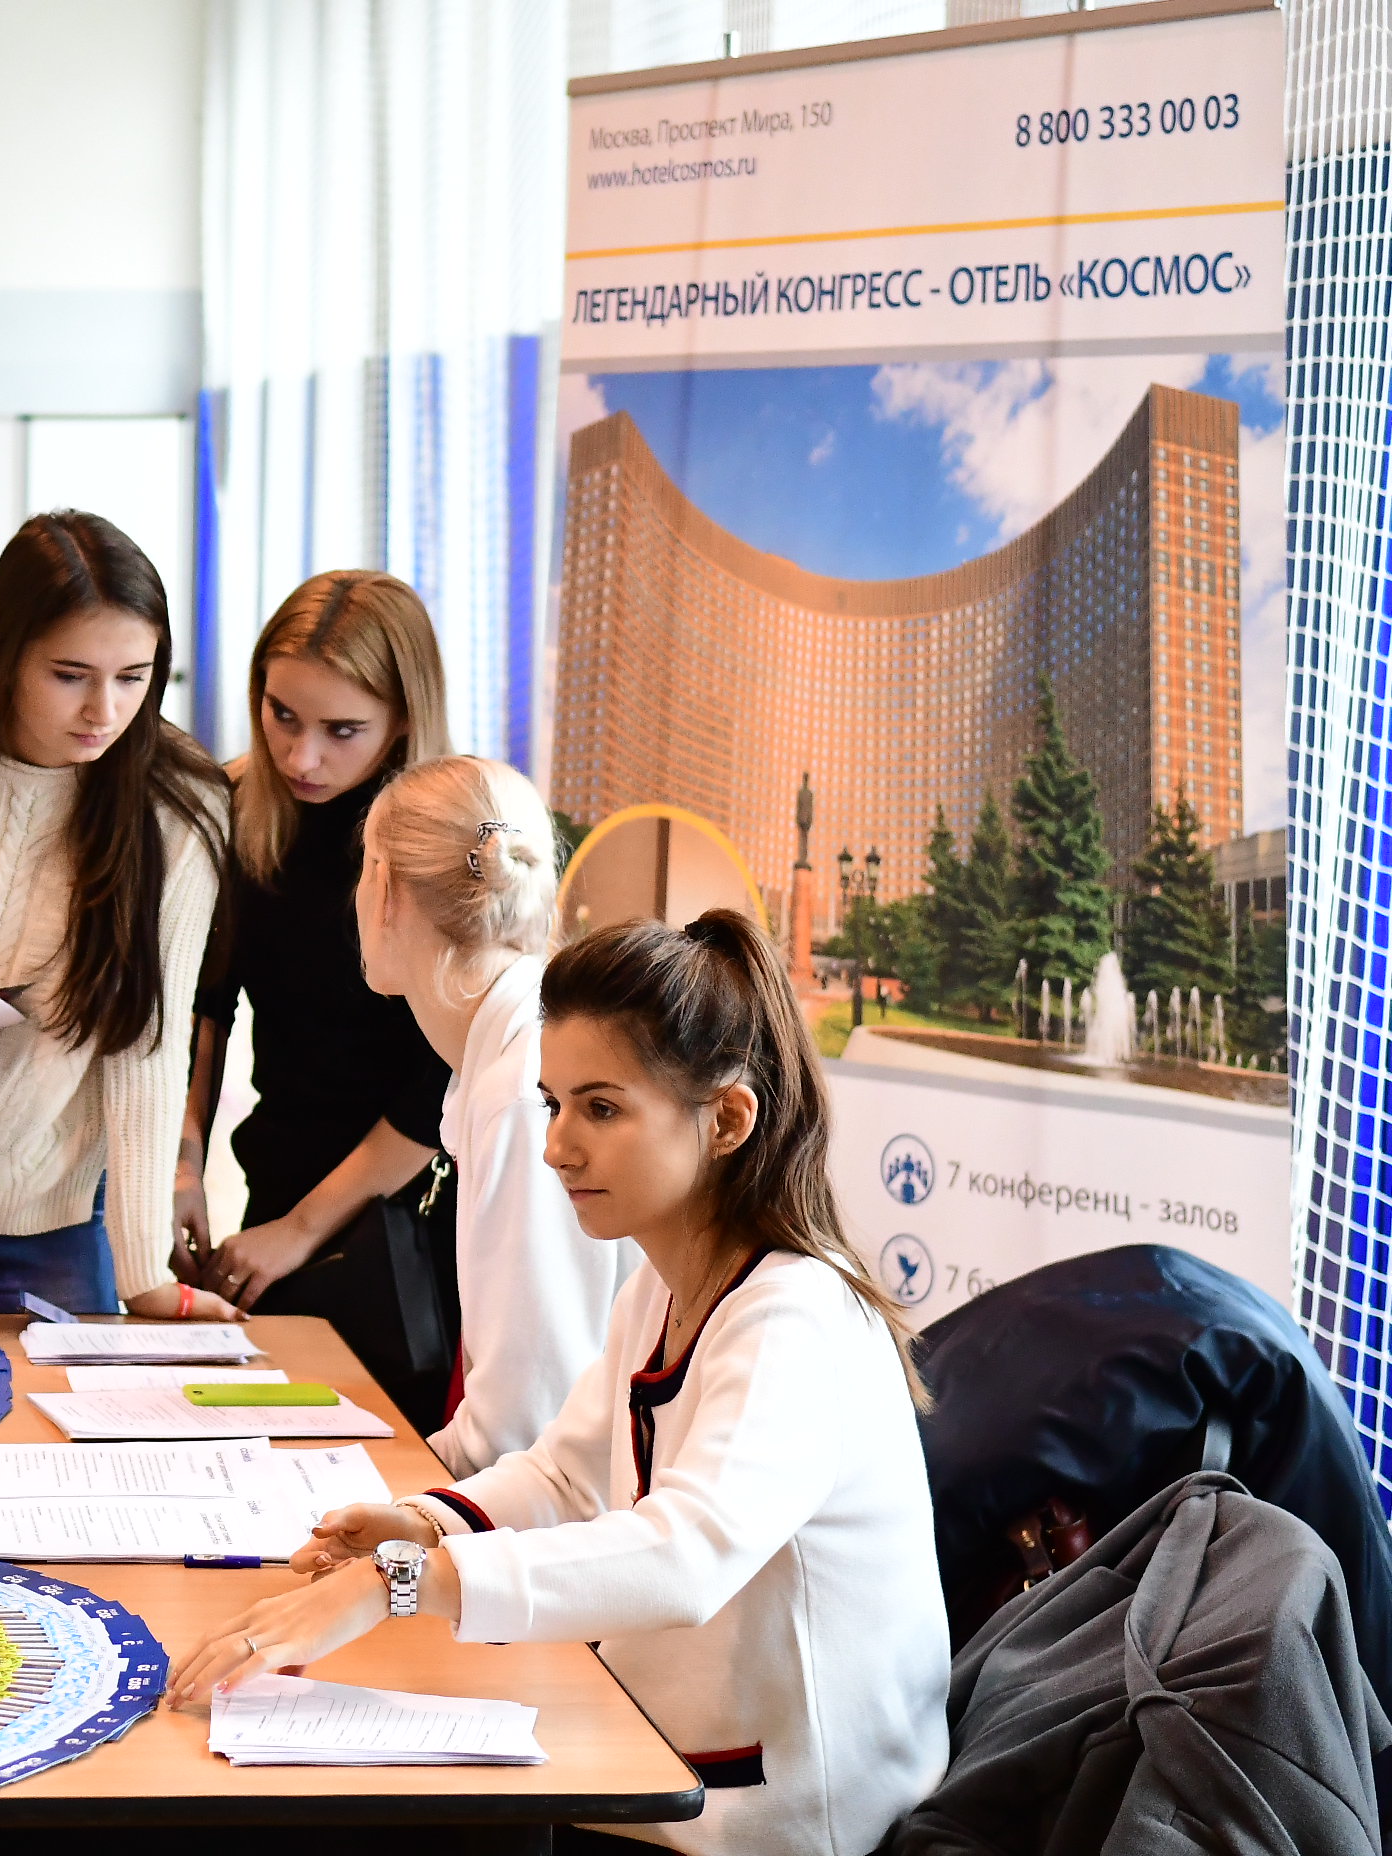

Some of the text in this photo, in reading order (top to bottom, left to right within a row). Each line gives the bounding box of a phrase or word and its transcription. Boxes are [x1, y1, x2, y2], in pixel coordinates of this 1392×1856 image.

[587, 101, 833, 150] Москва, Проспект Мира, 150
[1016, 93, 1240, 147] 8 800 333 00 03
[587, 157, 757, 189] www.hotelcosmos.ru
[573, 271, 770, 327] ЛЕГЕНДАРНЫЙ
[777, 269, 923, 314] КОНГРЕСС
[949, 263, 1051, 305] ОТЕЛЬ
[1058, 251, 1252, 299] «КОСМОС»
[946, 1160, 961, 1188] 7
[968, 1170, 1132, 1221] конференц
[1158, 1198, 1240, 1235] залов
[945, 1264, 960, 1293] 7
